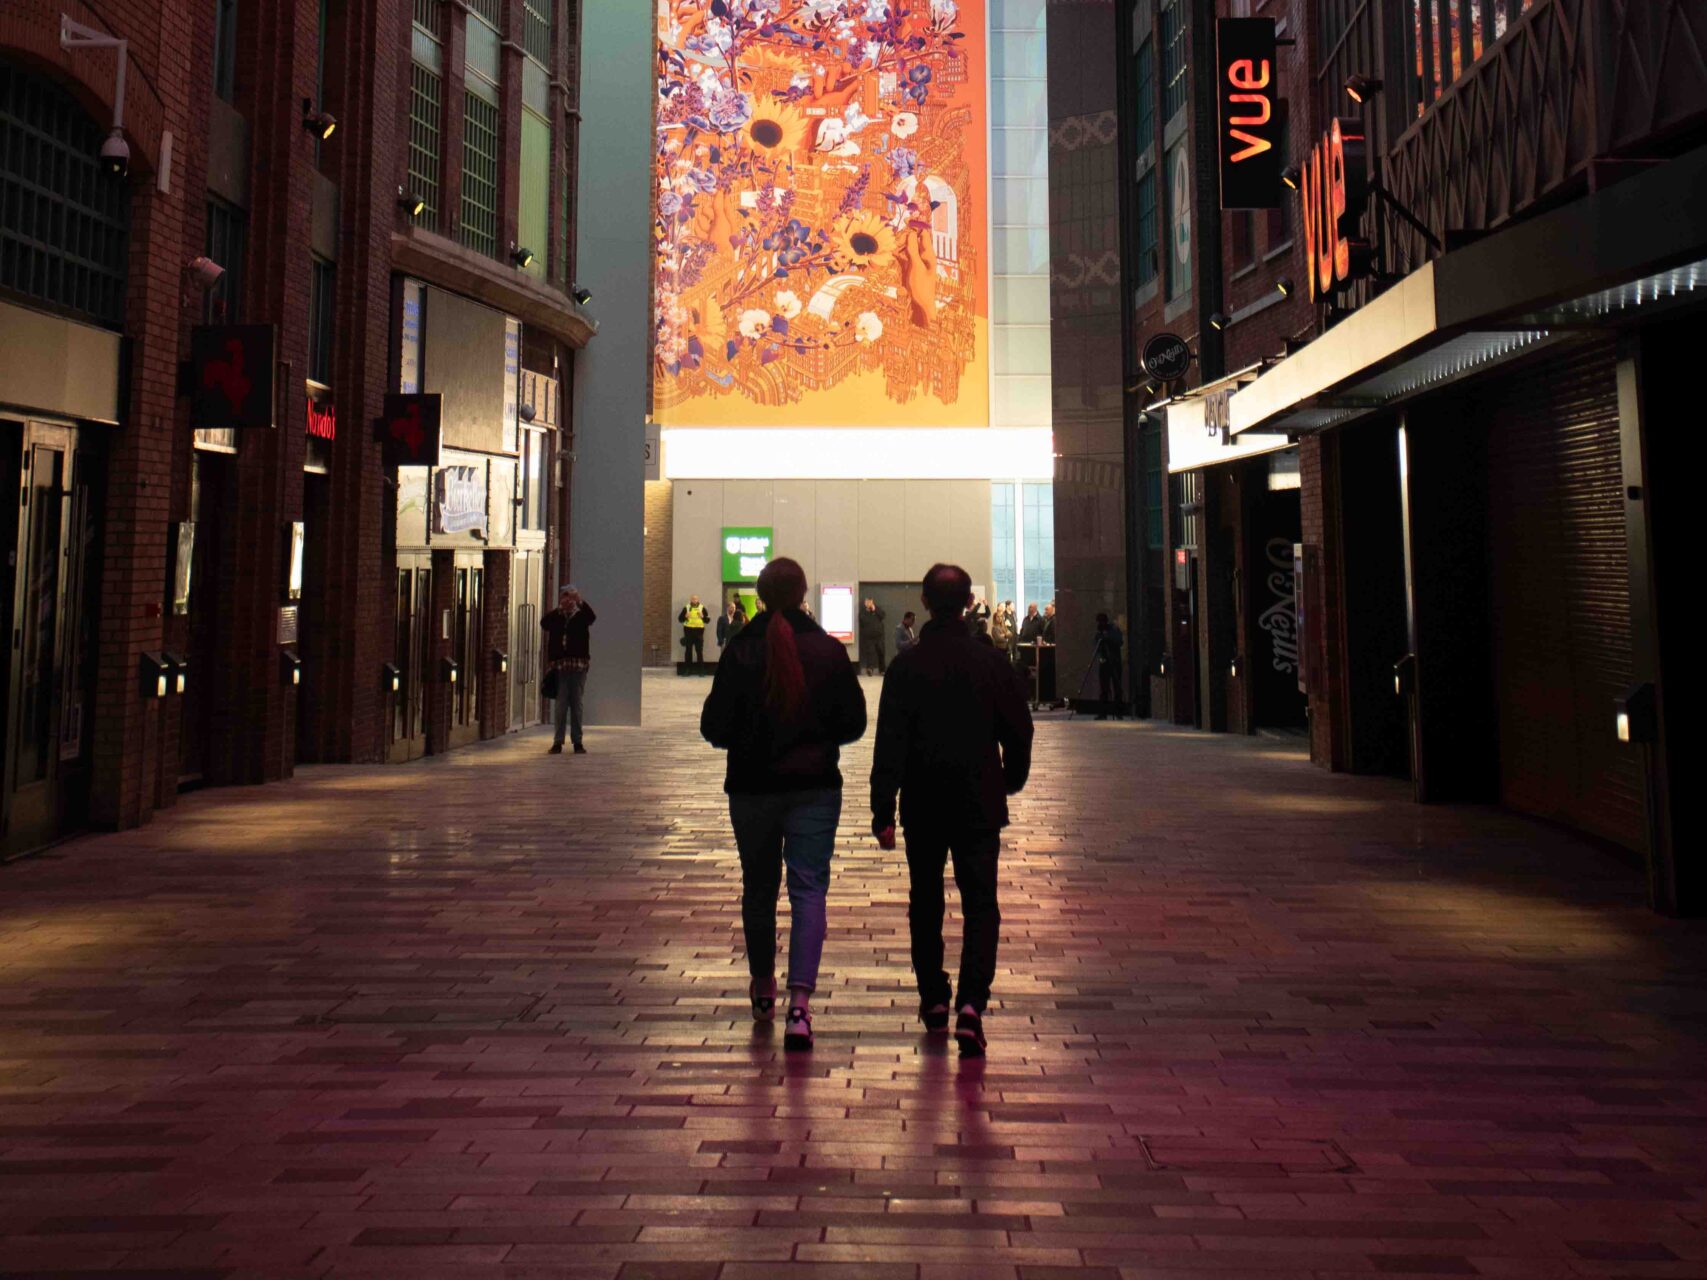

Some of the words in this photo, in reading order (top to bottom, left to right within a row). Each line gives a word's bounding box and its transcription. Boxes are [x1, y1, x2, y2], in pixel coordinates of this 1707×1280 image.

[1228, 58, 1272, 163] vue
[1302, 116, 1349, 305] vue
[305, 397, 336, 441] Nando's
